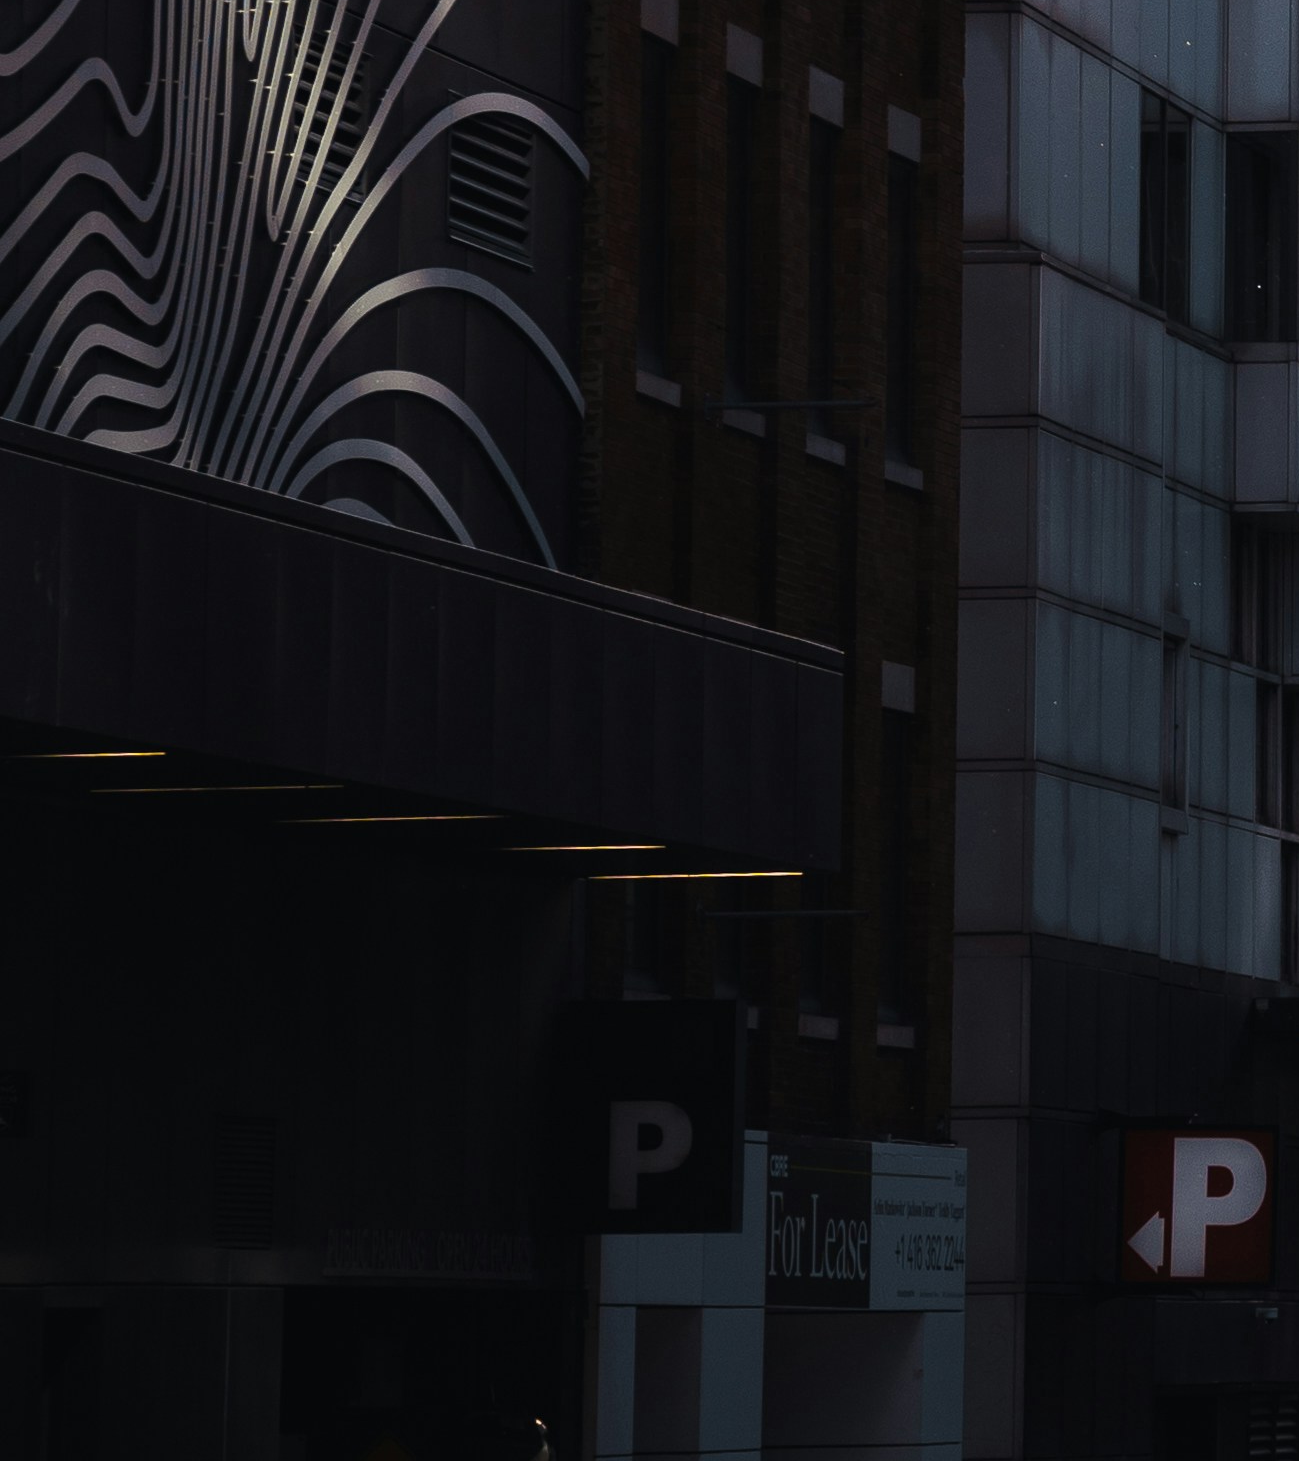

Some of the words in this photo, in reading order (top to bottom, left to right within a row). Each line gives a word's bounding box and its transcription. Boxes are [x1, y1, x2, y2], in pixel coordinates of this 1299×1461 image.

[607, 1100, 694, 1211] P
[769, 1154, 789, 1178] CBRE
[768, 1191, 806, 1278] For
[809, 1194, 868, 1281] Lease
[1170, 1136, 1268, 1279] P
